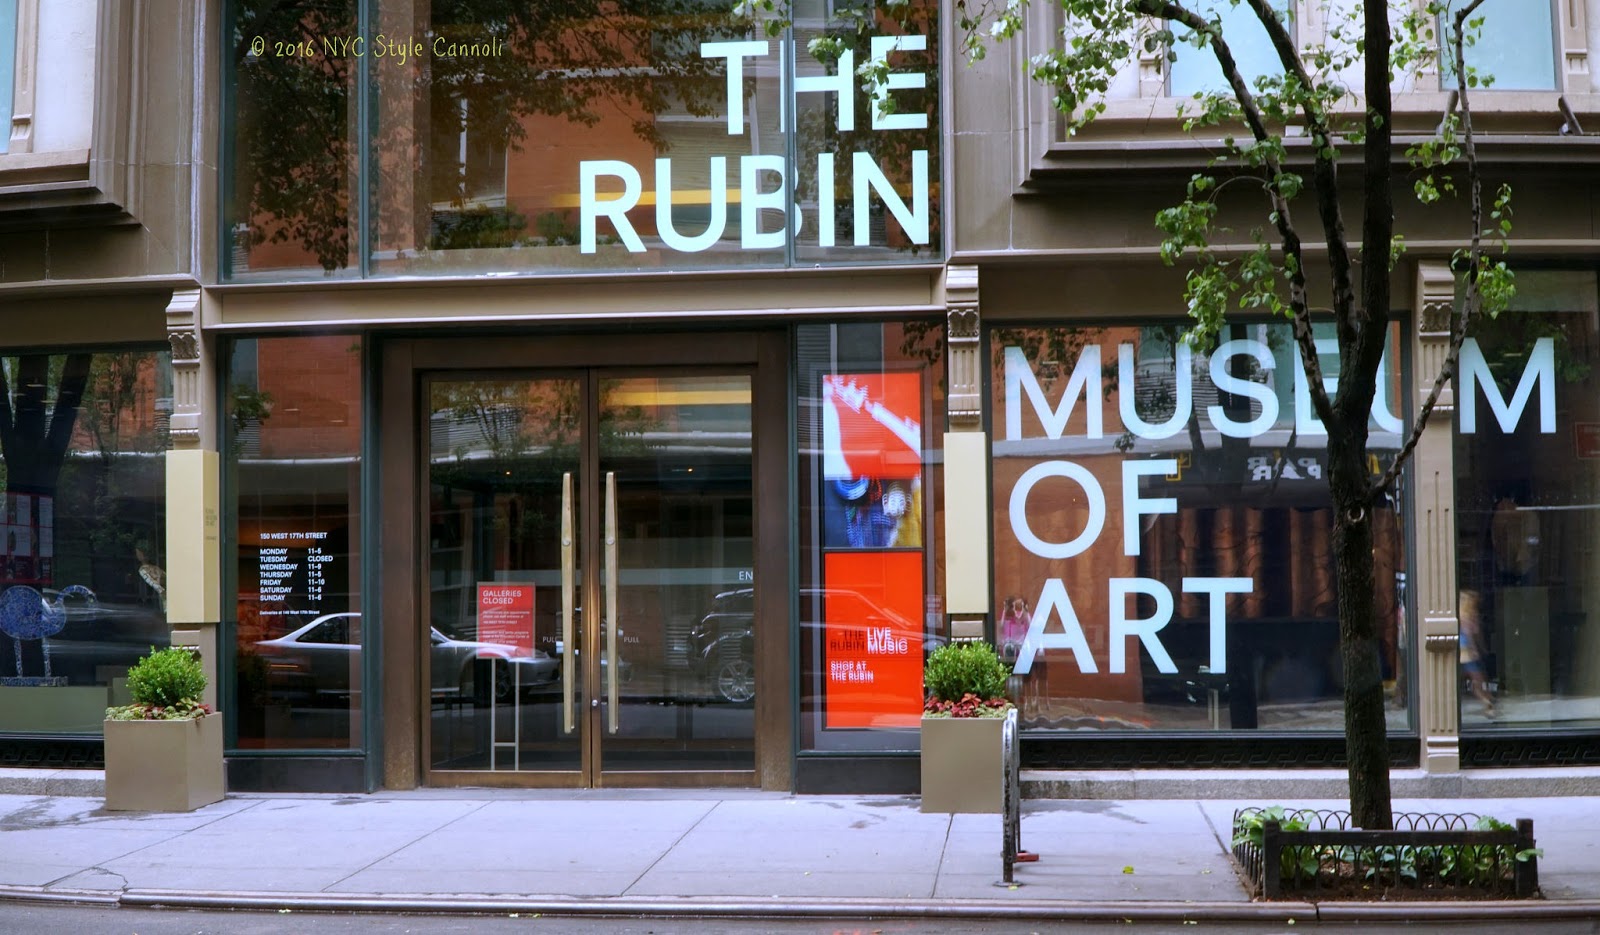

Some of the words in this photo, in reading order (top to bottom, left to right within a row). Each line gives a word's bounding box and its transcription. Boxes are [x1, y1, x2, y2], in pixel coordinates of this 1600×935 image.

[700, 35, 928, 135] THE
[579, 150, 930, 254] RUBIN
[1009, 459, 1178, 559] OF
[482, 589, 522, 598] GALLERIES
[482, 597, 514, 605] CLOSED
[1012, 577, 1254, 675] ART
[867, 627, 891, 641] LIVE
[830, 640, 865, 651] RUBIN
[867, 638, 908, 654] MUSIC
[831, 661, 854, 671] SHOP
[856, 661, 867, 671] AT
[831, 671, 847, 682] THE
[848, 671, 874, 683] RUBIN
